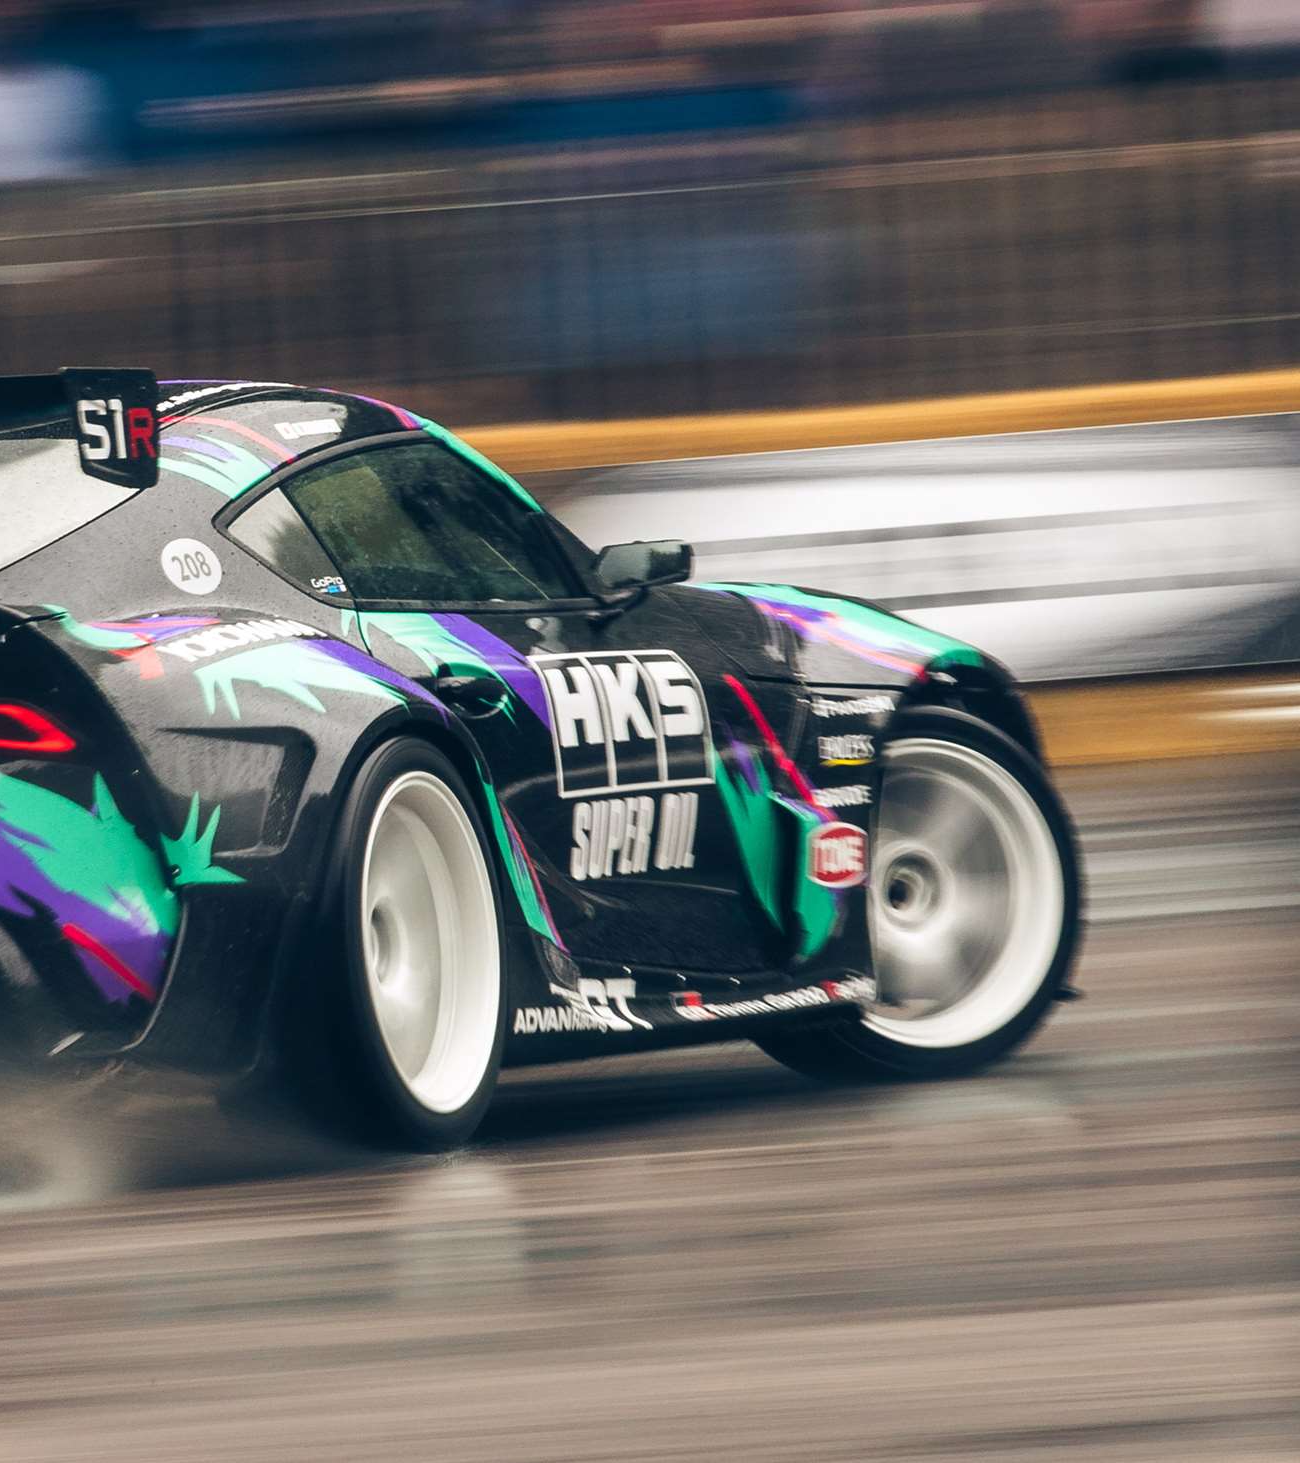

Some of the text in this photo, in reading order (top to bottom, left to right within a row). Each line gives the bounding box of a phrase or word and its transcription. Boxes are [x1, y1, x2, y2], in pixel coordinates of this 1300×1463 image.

[171, 551, 212, 582] 208
[310, 576, 344, 588] GoPro
[542, 661, 703, 747] HKS
[570, 795, 655, 881] SUPER
[513, 1005, 571, 1034] ADVAN
